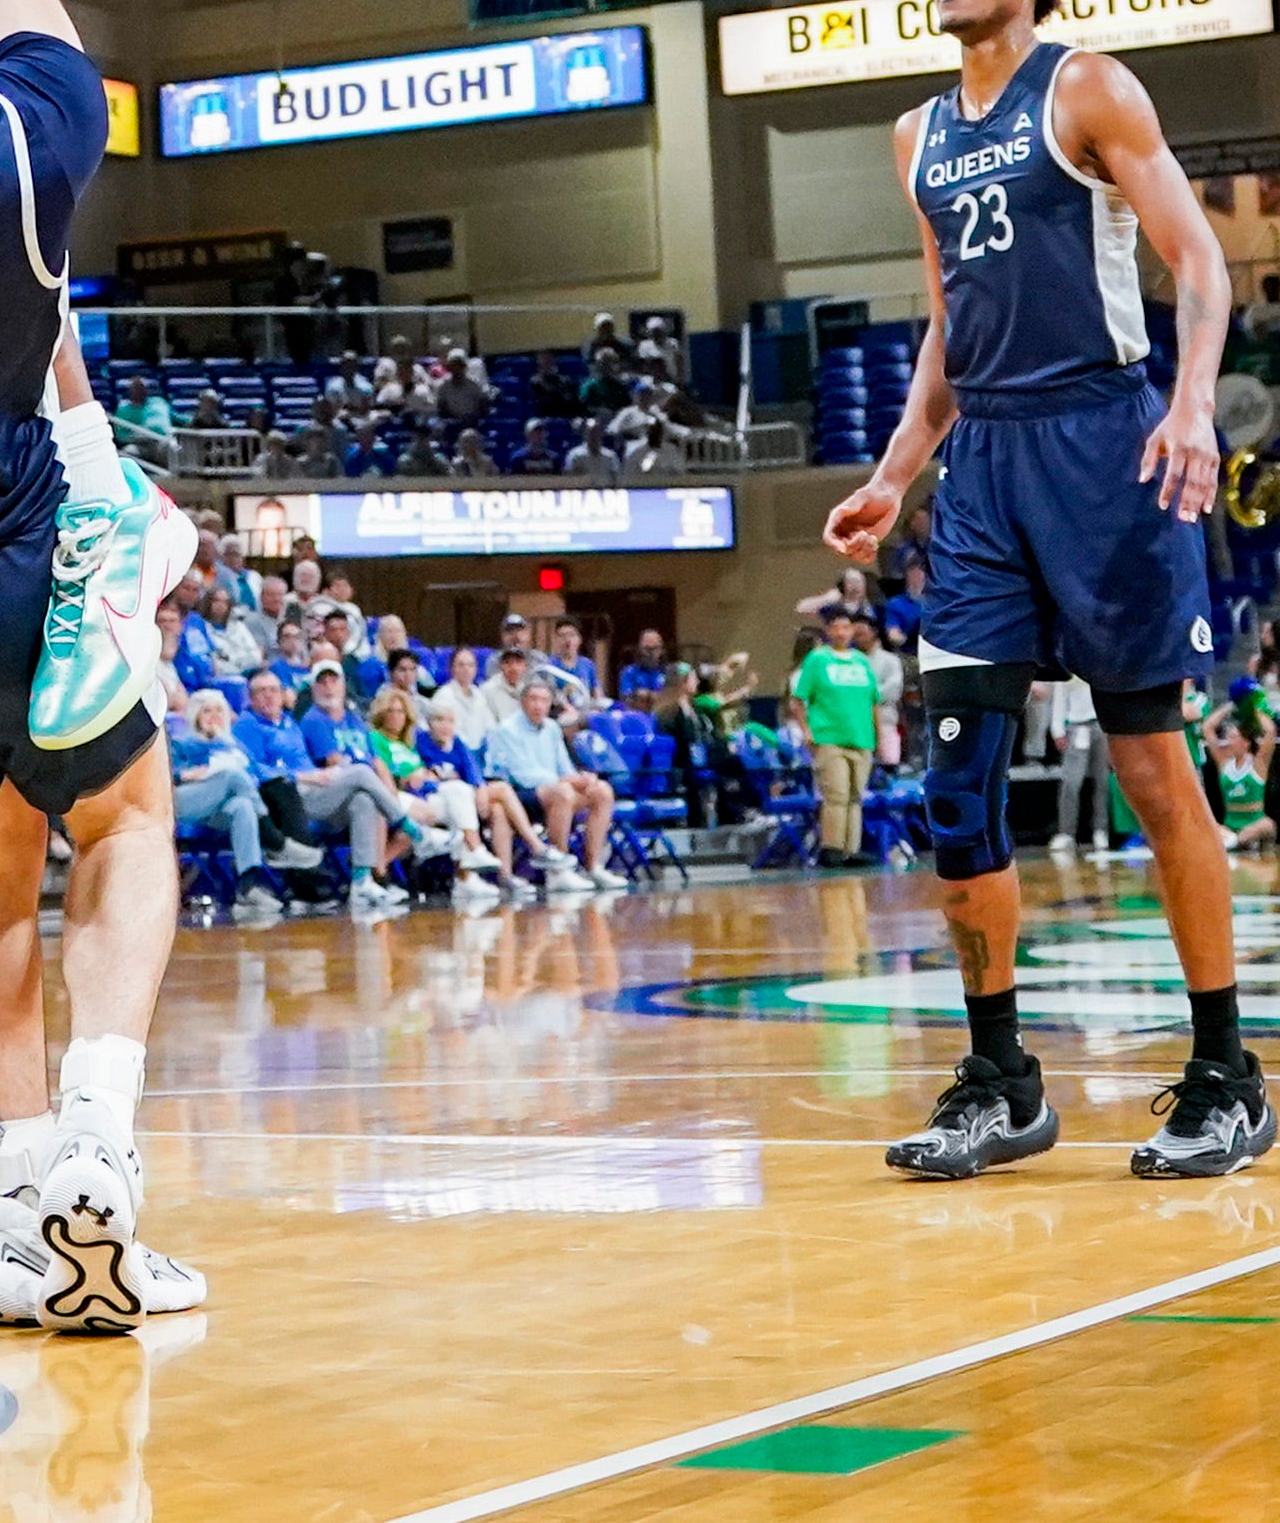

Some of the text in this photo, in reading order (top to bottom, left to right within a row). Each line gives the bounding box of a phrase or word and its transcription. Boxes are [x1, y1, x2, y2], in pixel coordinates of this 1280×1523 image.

[272, 62, 518, 125] BUD LIGHT
[925, 136, 1032, 189] QUEENS
[951, 183, 1015, 261] 23
